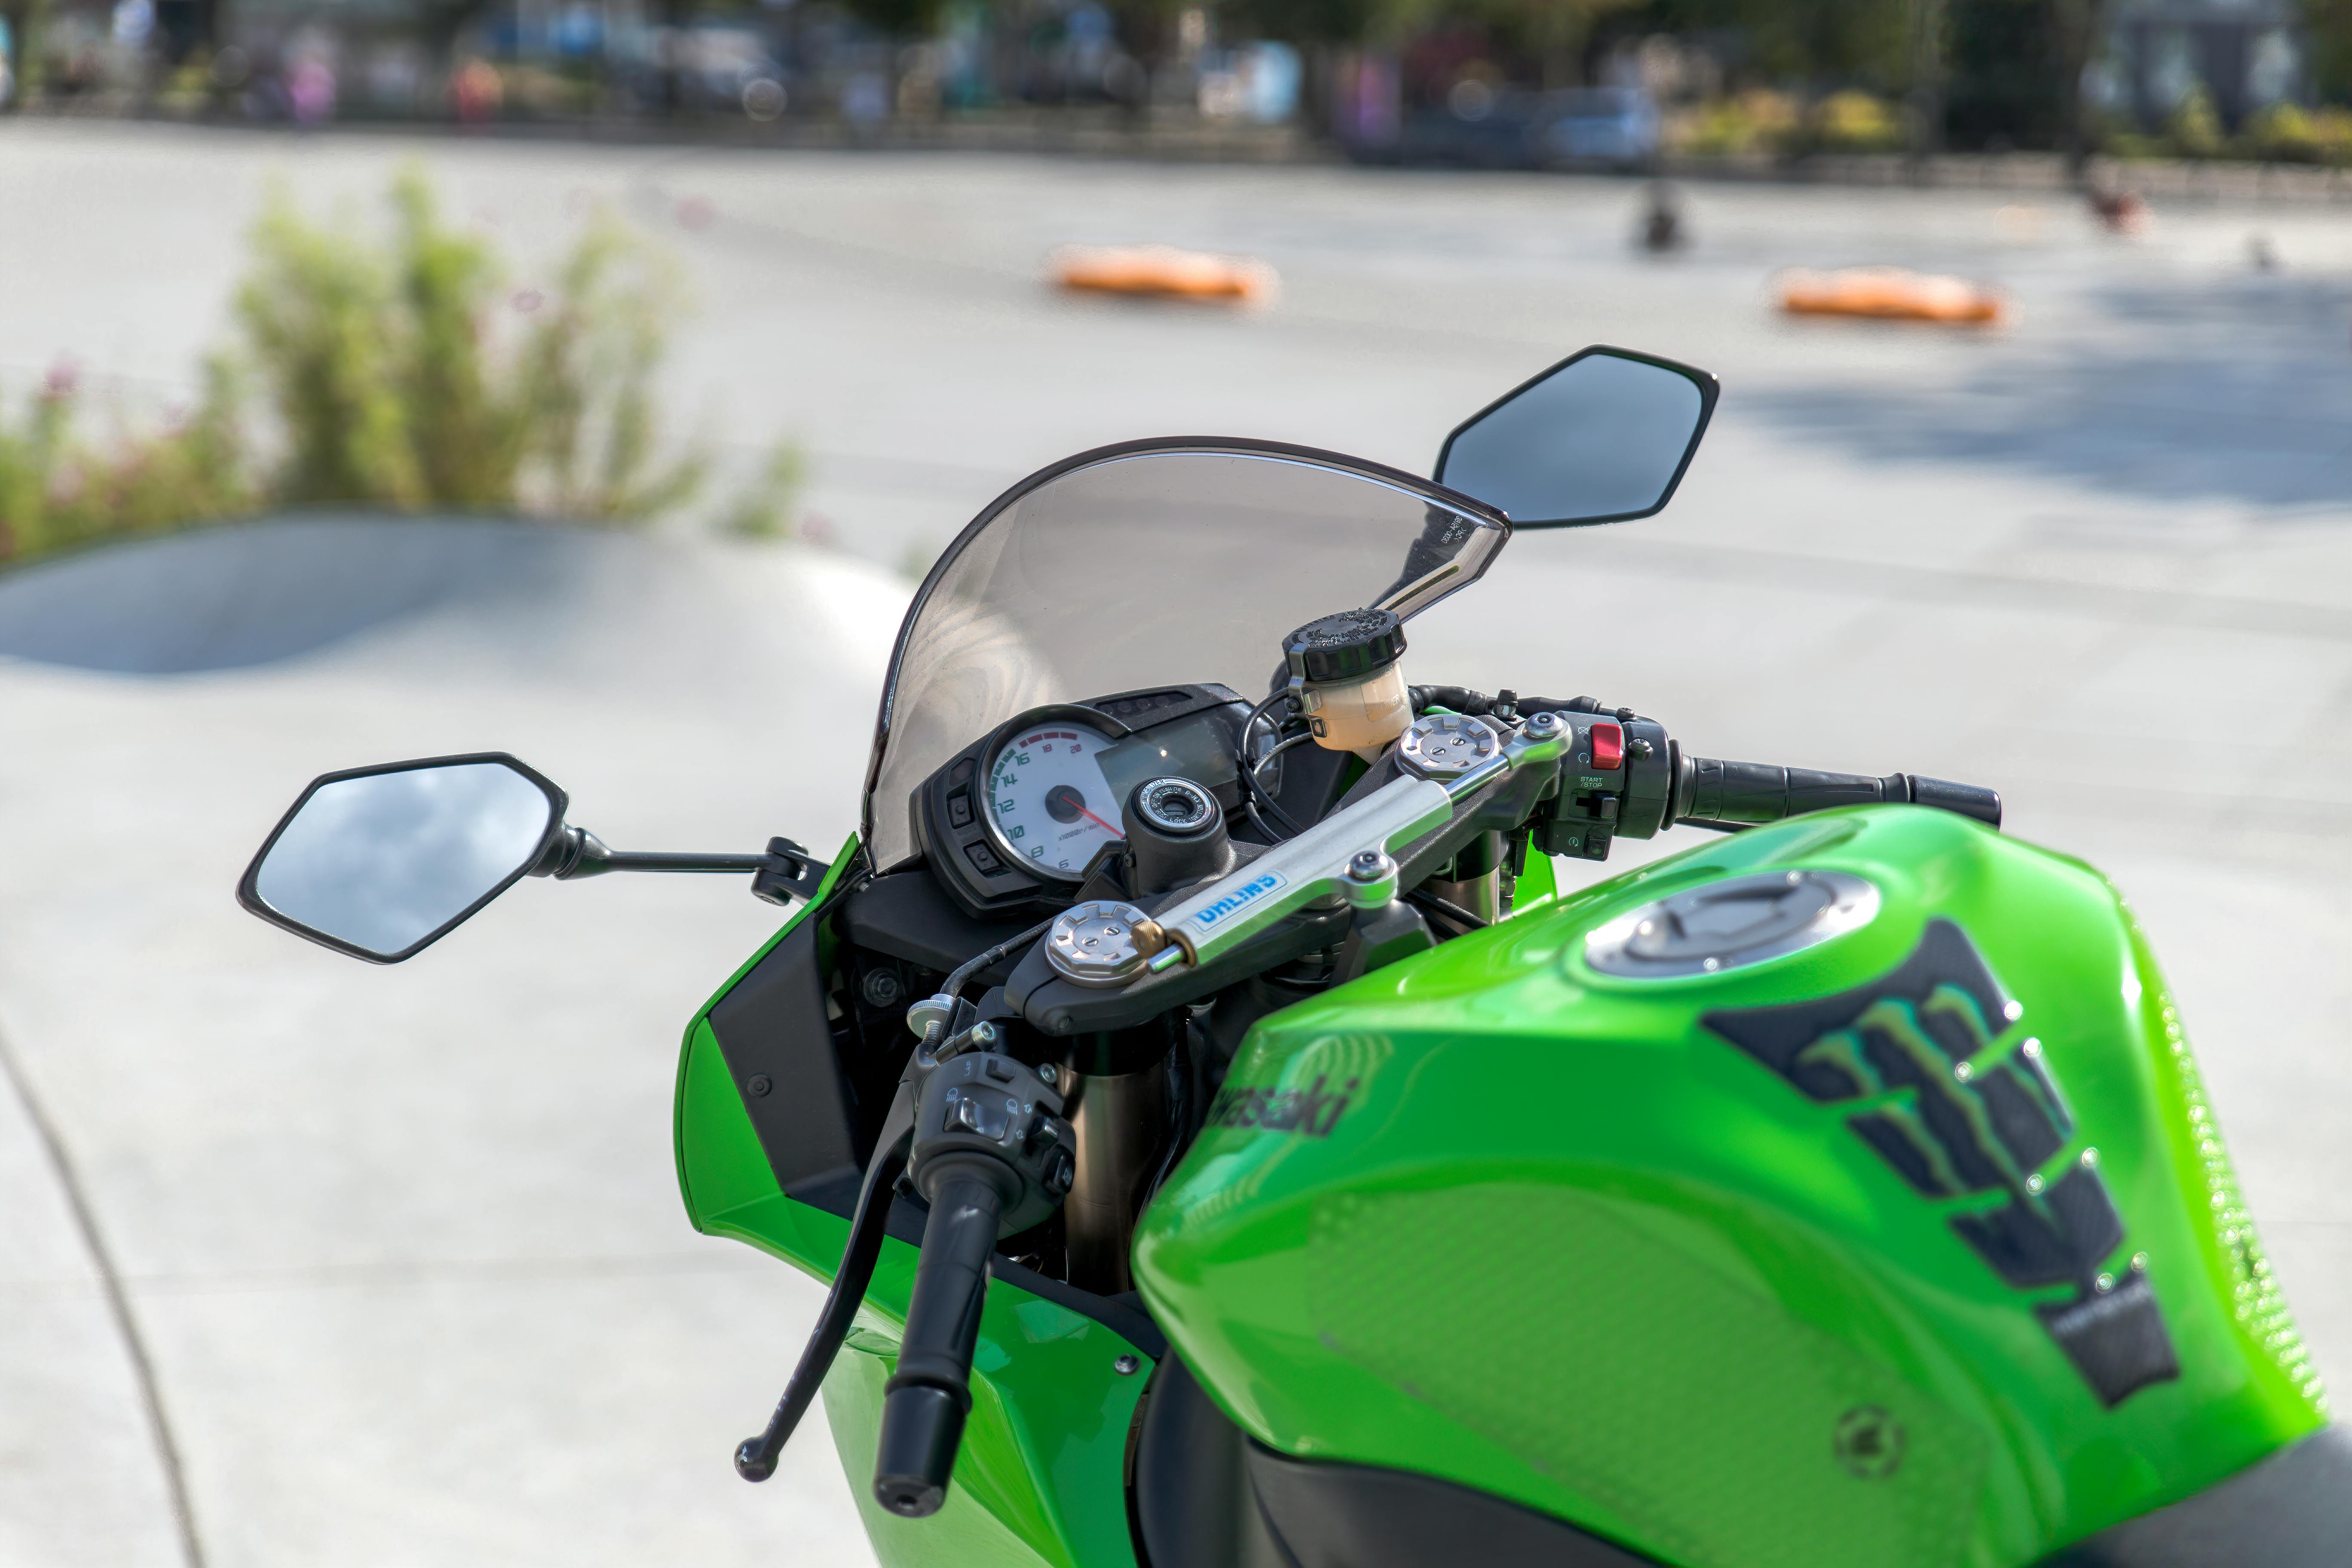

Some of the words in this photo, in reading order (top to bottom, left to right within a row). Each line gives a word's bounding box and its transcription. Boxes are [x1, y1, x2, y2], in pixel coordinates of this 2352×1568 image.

[1042, 744, 1052, 753] 18
[1070, 744, 1081, 754] 20
[1014, 752, 1030, 766] 16
[1001, 773, 1018, 787] 14
[997, 799, 1015, 814] 12
[1007, 824, 1025, 840] 10
[1031, 845, 1044, 858] 8
[1059, 859, 1069, 869] 6
